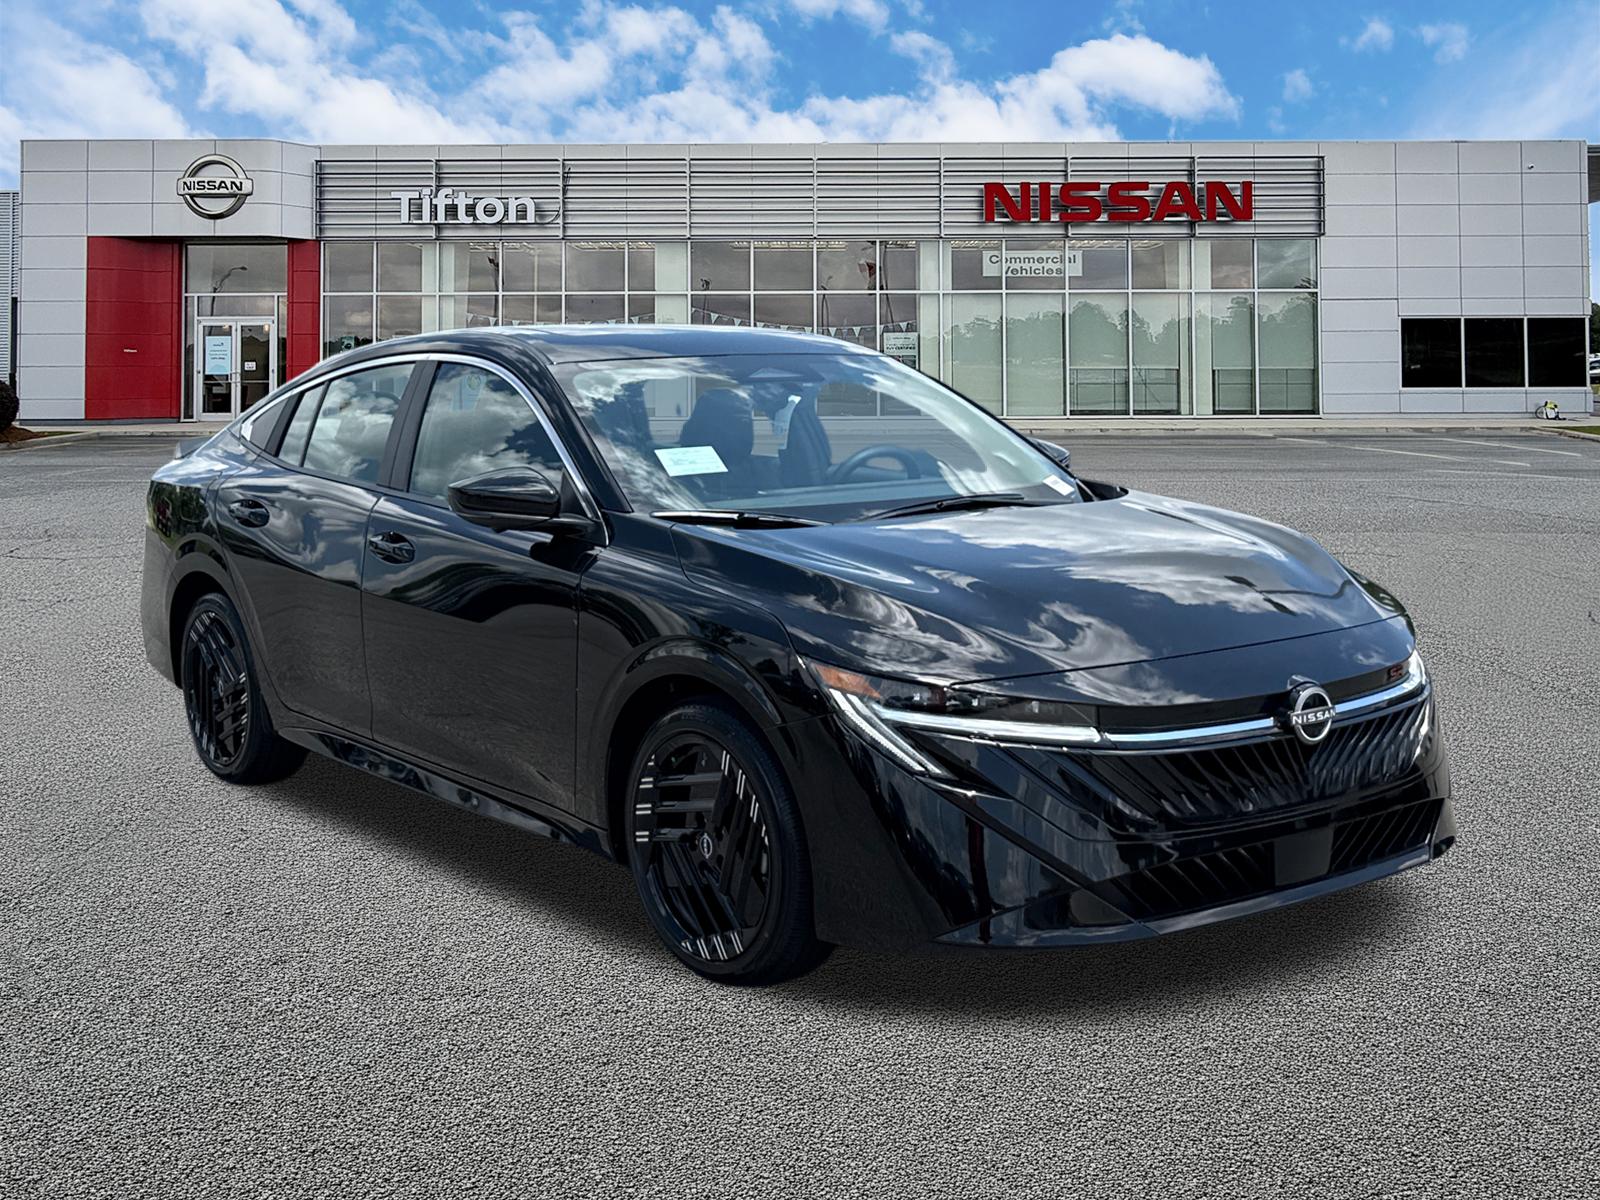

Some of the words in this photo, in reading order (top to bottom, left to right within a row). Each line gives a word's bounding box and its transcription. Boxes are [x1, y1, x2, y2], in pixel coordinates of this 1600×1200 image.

[182, 179, 244, 193] NISSAN
[390, 187, 536, 224] Tifton
[983, 180, 1254, 223] NISSAN
[1292, 709, 1336, 725] NISSAN
